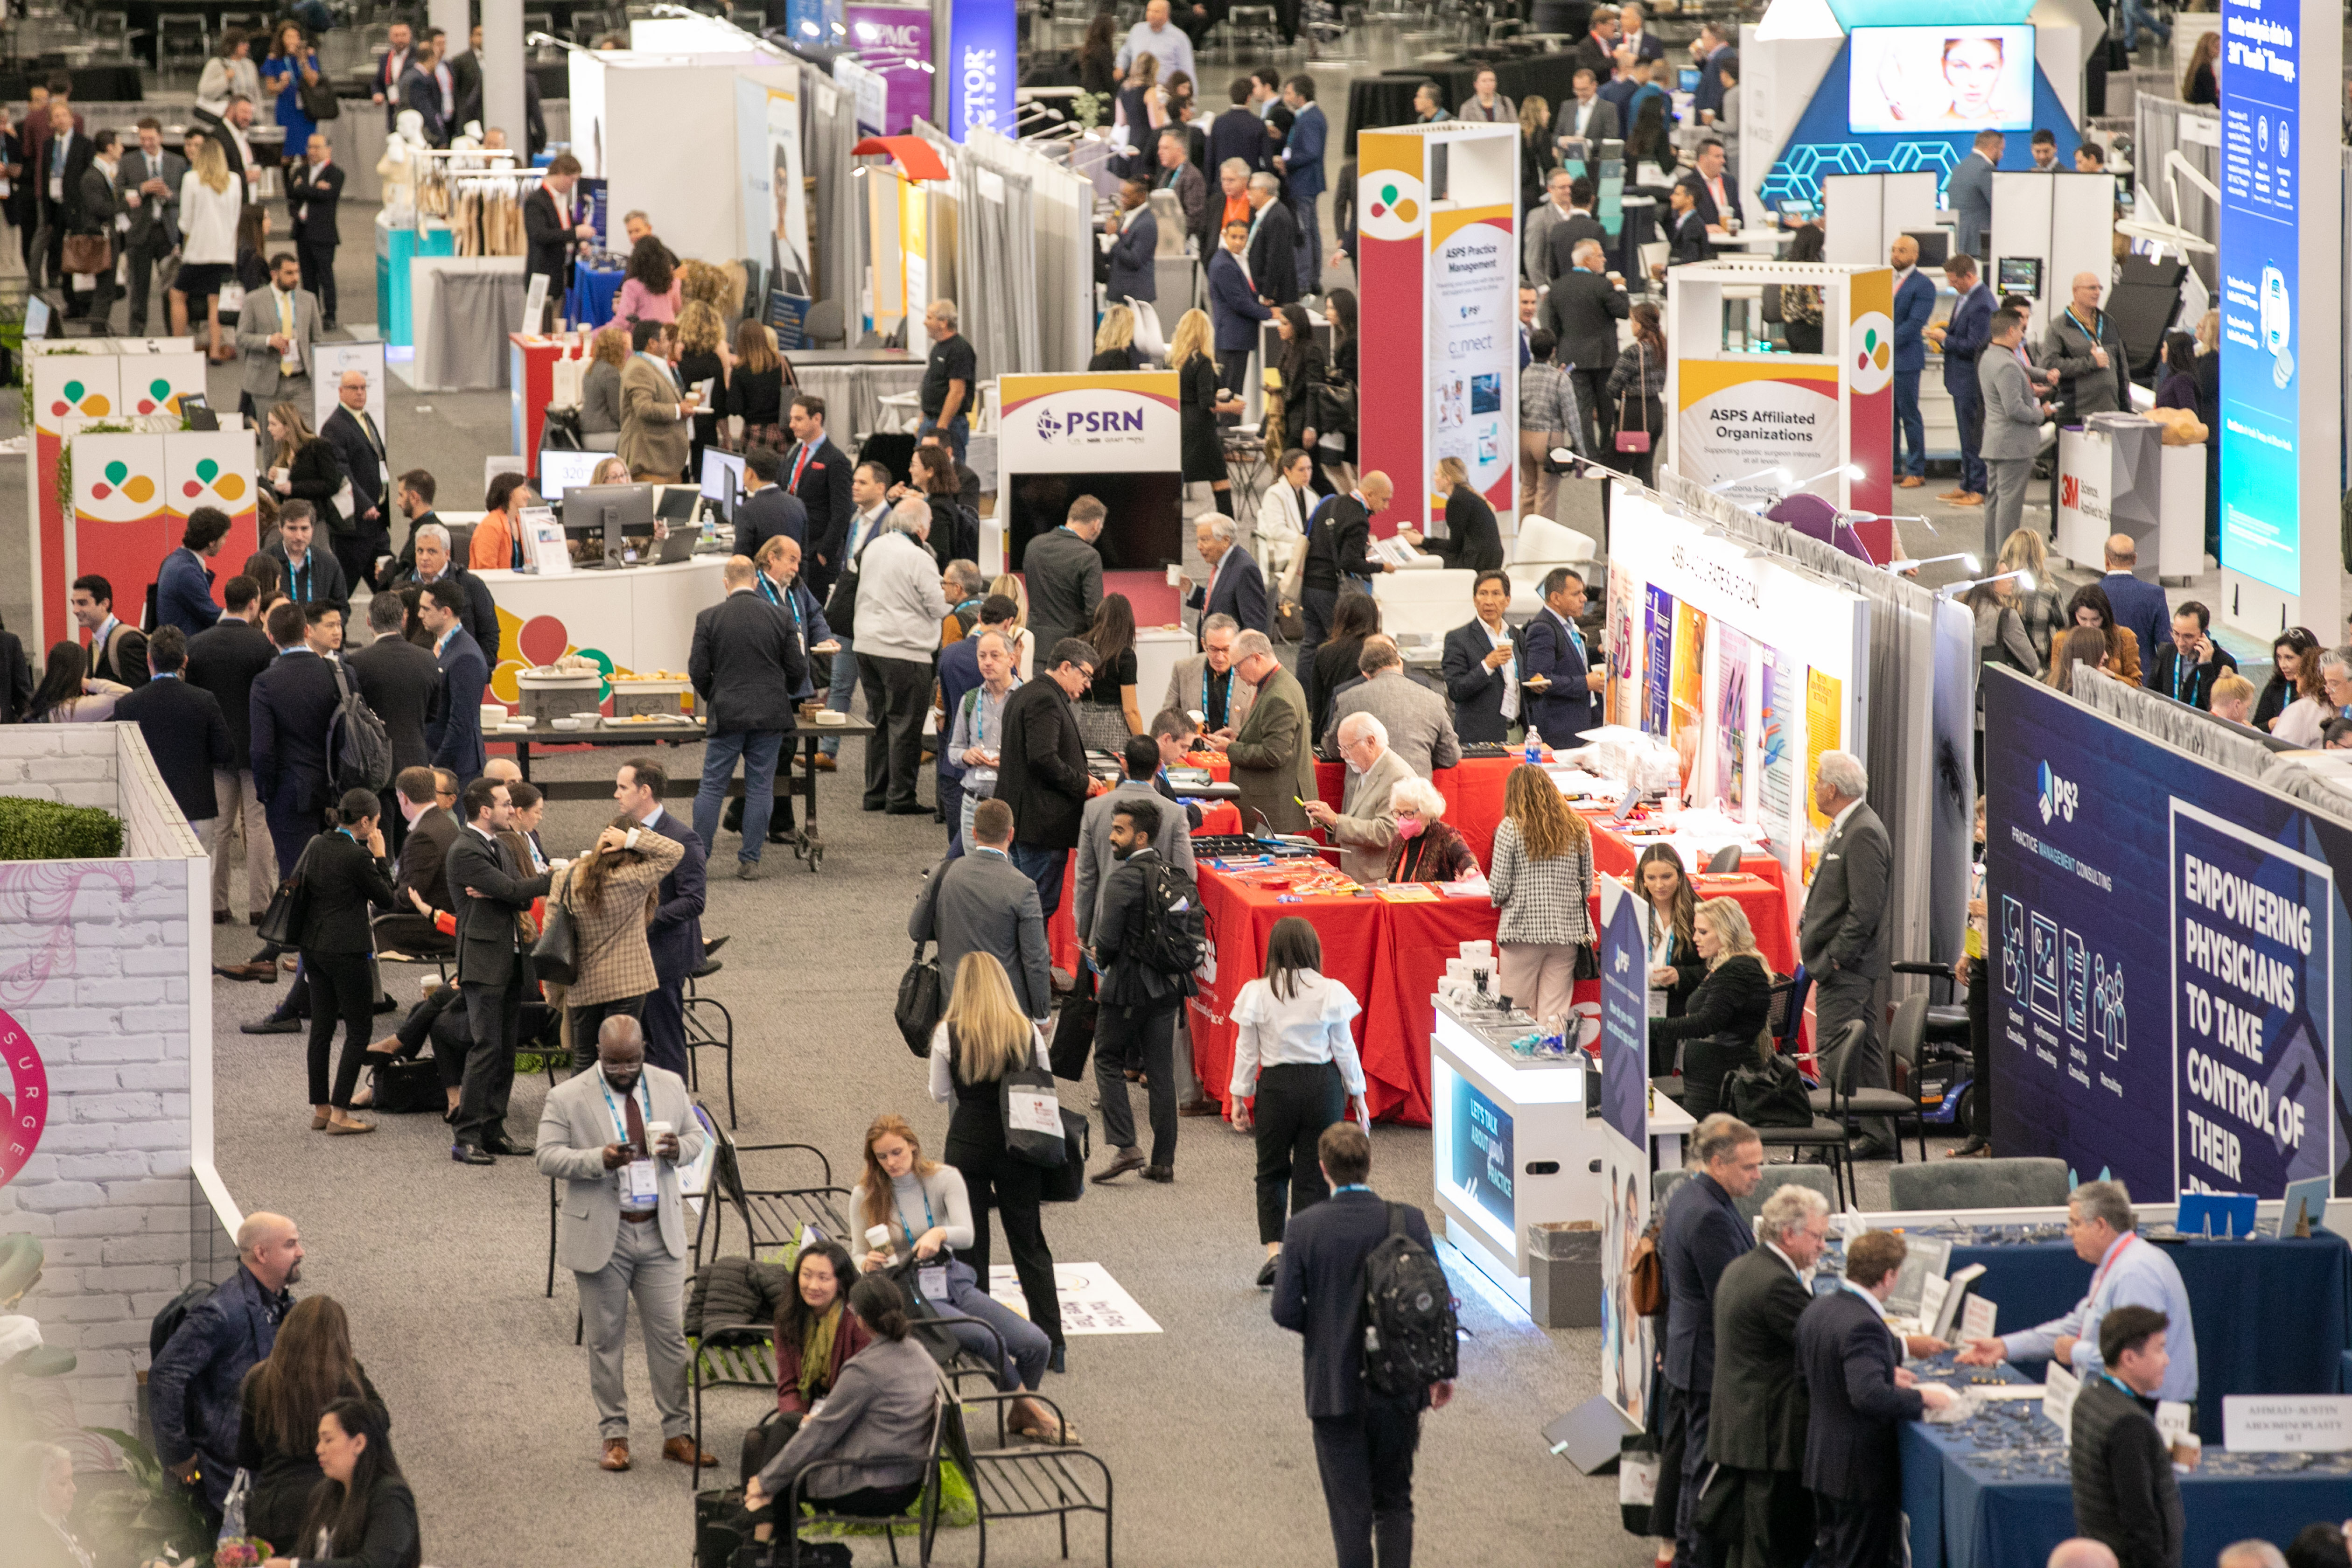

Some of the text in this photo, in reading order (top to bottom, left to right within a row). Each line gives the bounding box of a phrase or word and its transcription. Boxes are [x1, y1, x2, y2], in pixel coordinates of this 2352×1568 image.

[860, 24, 920, 46] PMC
[964, 49, 986, 143] CTOR
[1446, 244, 1497, 258] ASPS Practice
[1448, 259, 1497, 273] Management
[1449, 335, 1492, 353] cnnect
[1067, 406, 1143, 436] PSRN
[1710, 408, 1815, 425] ASPS Affiliated
[1716, 426, 1813, 441] Organizations
[1704, 446, 1739, 455] Supporting
[1741, 448, 1762, 456] plastic
[562, 467, 584, 479] 320
[1724, 483, 1752, 493] rizona
[2061, 473, 2079, 511] 3M
[2081, 499, 2098, 518] Applied
[2011, 826, 2112, 893] PRACTICE MANAGEMENT CONSULTING
[2185, 853, 2312, 956] EMPOWERING
[2185, 917, 2295, 1014] PHYSICIANS
[2186, 980, 2263, 1064] TO TAKE
[2186, 1047, 2305, 1149] CONTROL OF
[1470, 1097, 1498, 1137] LET'S TALK
[1471, 1123, 1489, 1154] ABOUT
[2187, 1109, 2241, 1184] THEIR
[1487, 1163, 1512, 1199] PRACTICE
